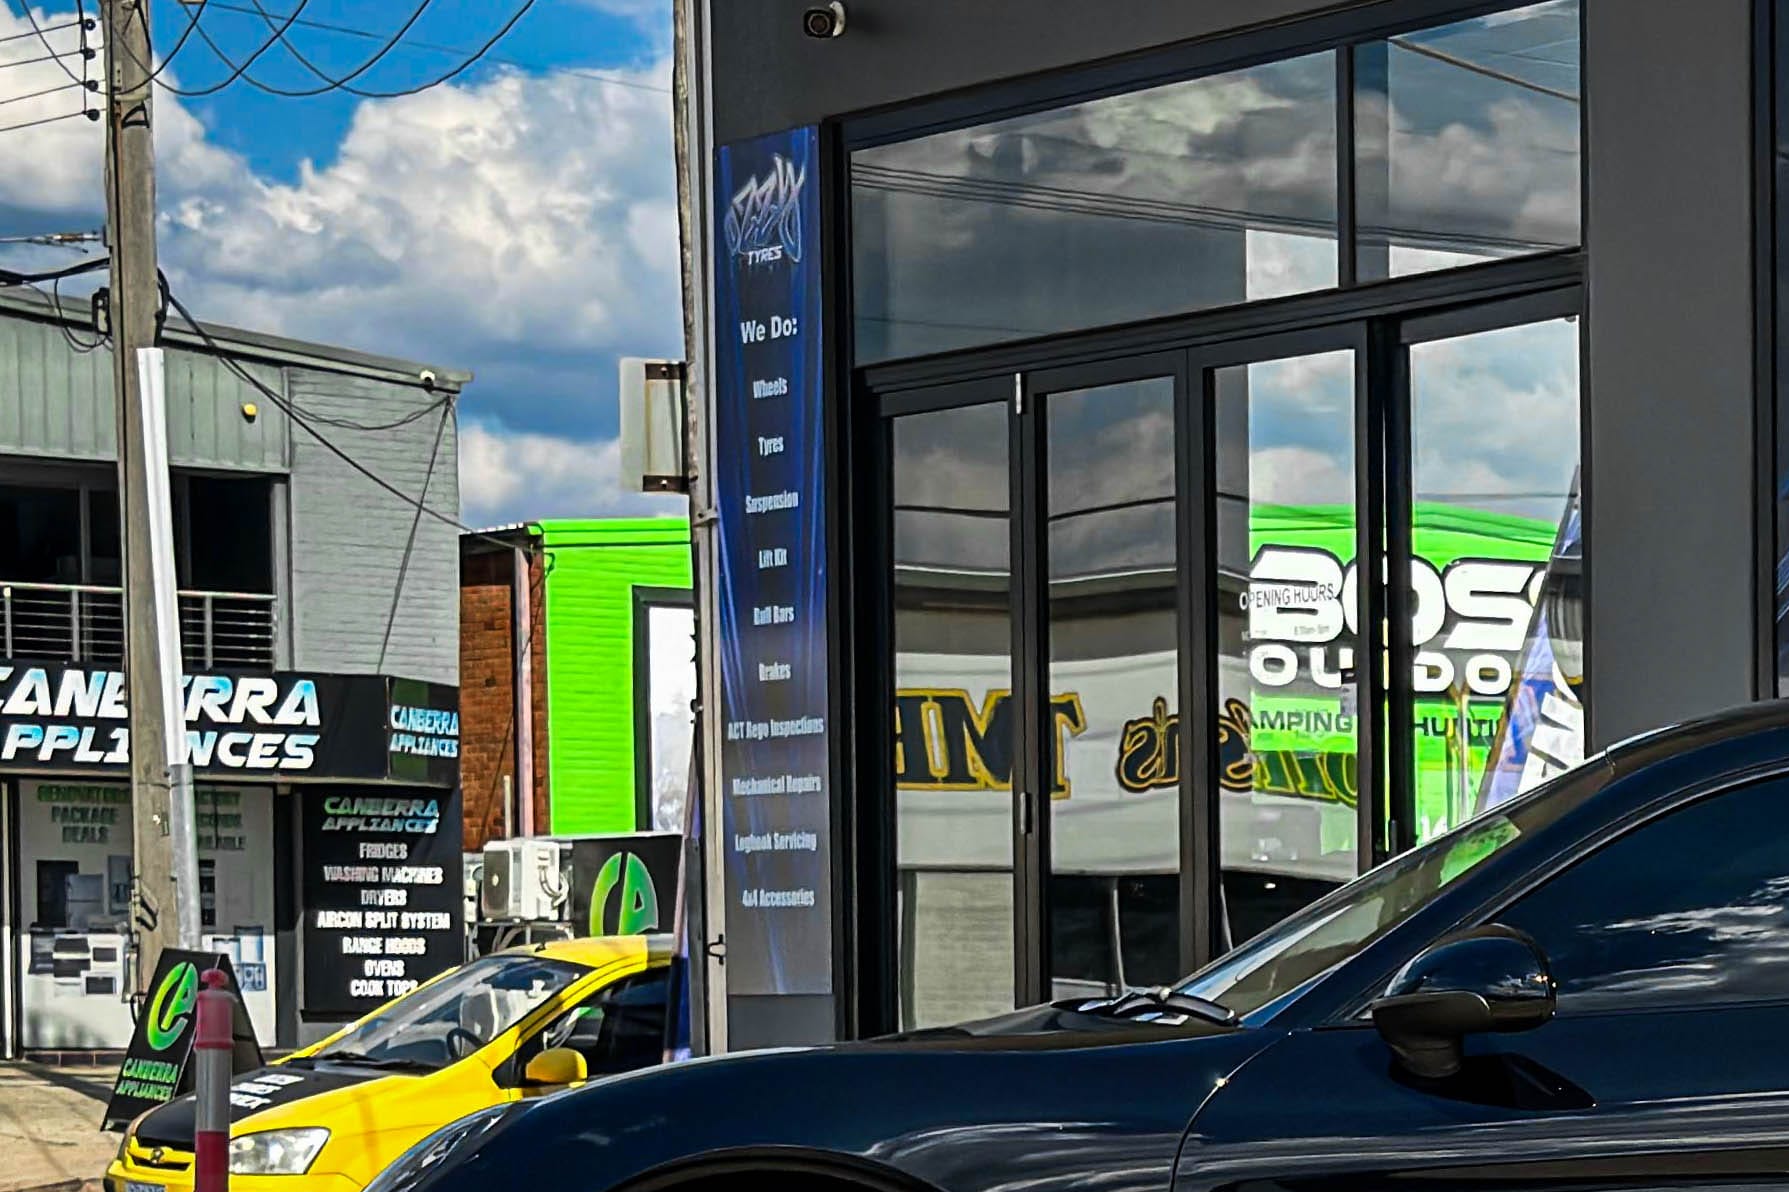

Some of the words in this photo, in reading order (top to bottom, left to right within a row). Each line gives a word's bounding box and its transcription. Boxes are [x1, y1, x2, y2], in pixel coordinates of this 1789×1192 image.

[747, 245, 784, 266] TYRES
[740, 320, 765, 344] We
[770, 315, 799, 339] Do:
[752, 377, 789, 399] Wheels
[757, 435, 785, 457] Tyres
[745, 490, 800, 515] Suspension
[1239, 587, 1291, 611] OPENING
[1293, 583, 1335, 603] HOURS
[390, 704, 459, 736] CANBERRA
[728, 721, 745, 741] ACT
[389, 733, 459, 758] APPLIANCES
[732, 775, 785, 797] Mechanical
[323, 796, 440, 818] CANBERRA
[321, 815, 440, 834] APPLIANCES
[359, 842, 408, 859] FRIDGES
[774, 831, 818, 854] Servicing
[323, 866, 379, 882] WASHING
[381, 866, 444, 884] MACHINES
[360, 889, 408, 906] DRYERS
[759, 887, 815, 908] Accessories
[316, 910, 363, 930] AIRCON
[365, 911, 399, 929] SPLIT
[400, 911, 451, 930] SYSTEM
[342, 936, 383, 954] RANGE
[385, 937, 427, 955] HOODS
[364, 959, 405, 977] OVENS
[350, 979, 384, 998] COOK
[122, 1057, 179, 1084] CANBERRA
[115, 1080, 173, 1102] APPLIANCES
